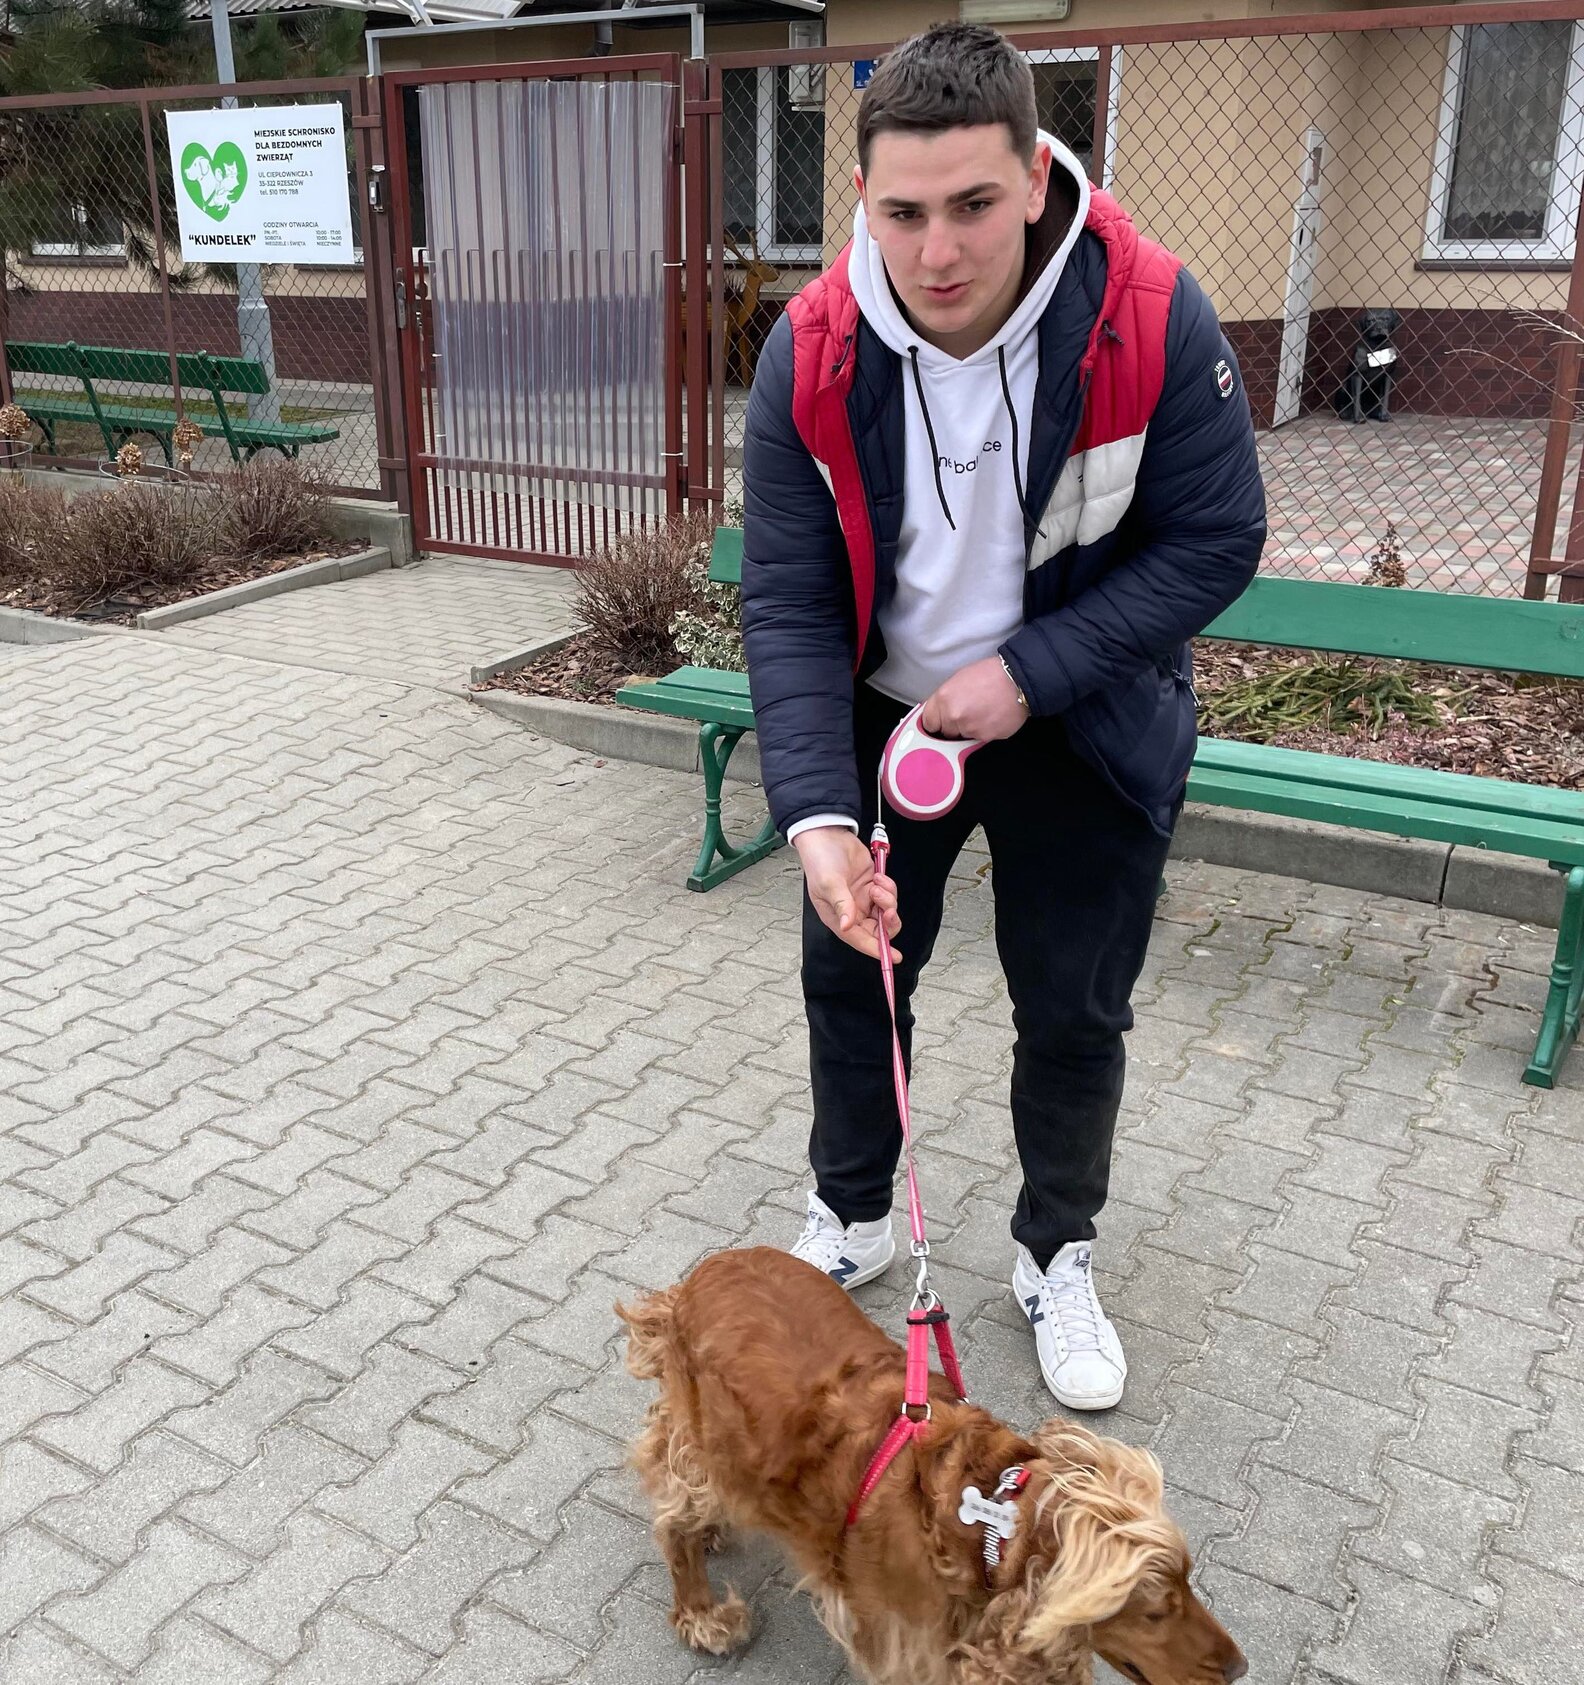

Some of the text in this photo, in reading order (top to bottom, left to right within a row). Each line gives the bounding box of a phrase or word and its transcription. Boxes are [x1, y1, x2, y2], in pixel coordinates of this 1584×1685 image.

[254, 127, 336, 138] MIEJSKIE SCHRONISKO
[272, 140, 322, 149] BEZDOMNYCH
[256, 153, 294, 162] ZWIERZĄT
[1024, 1294, 1045, 1324] N
